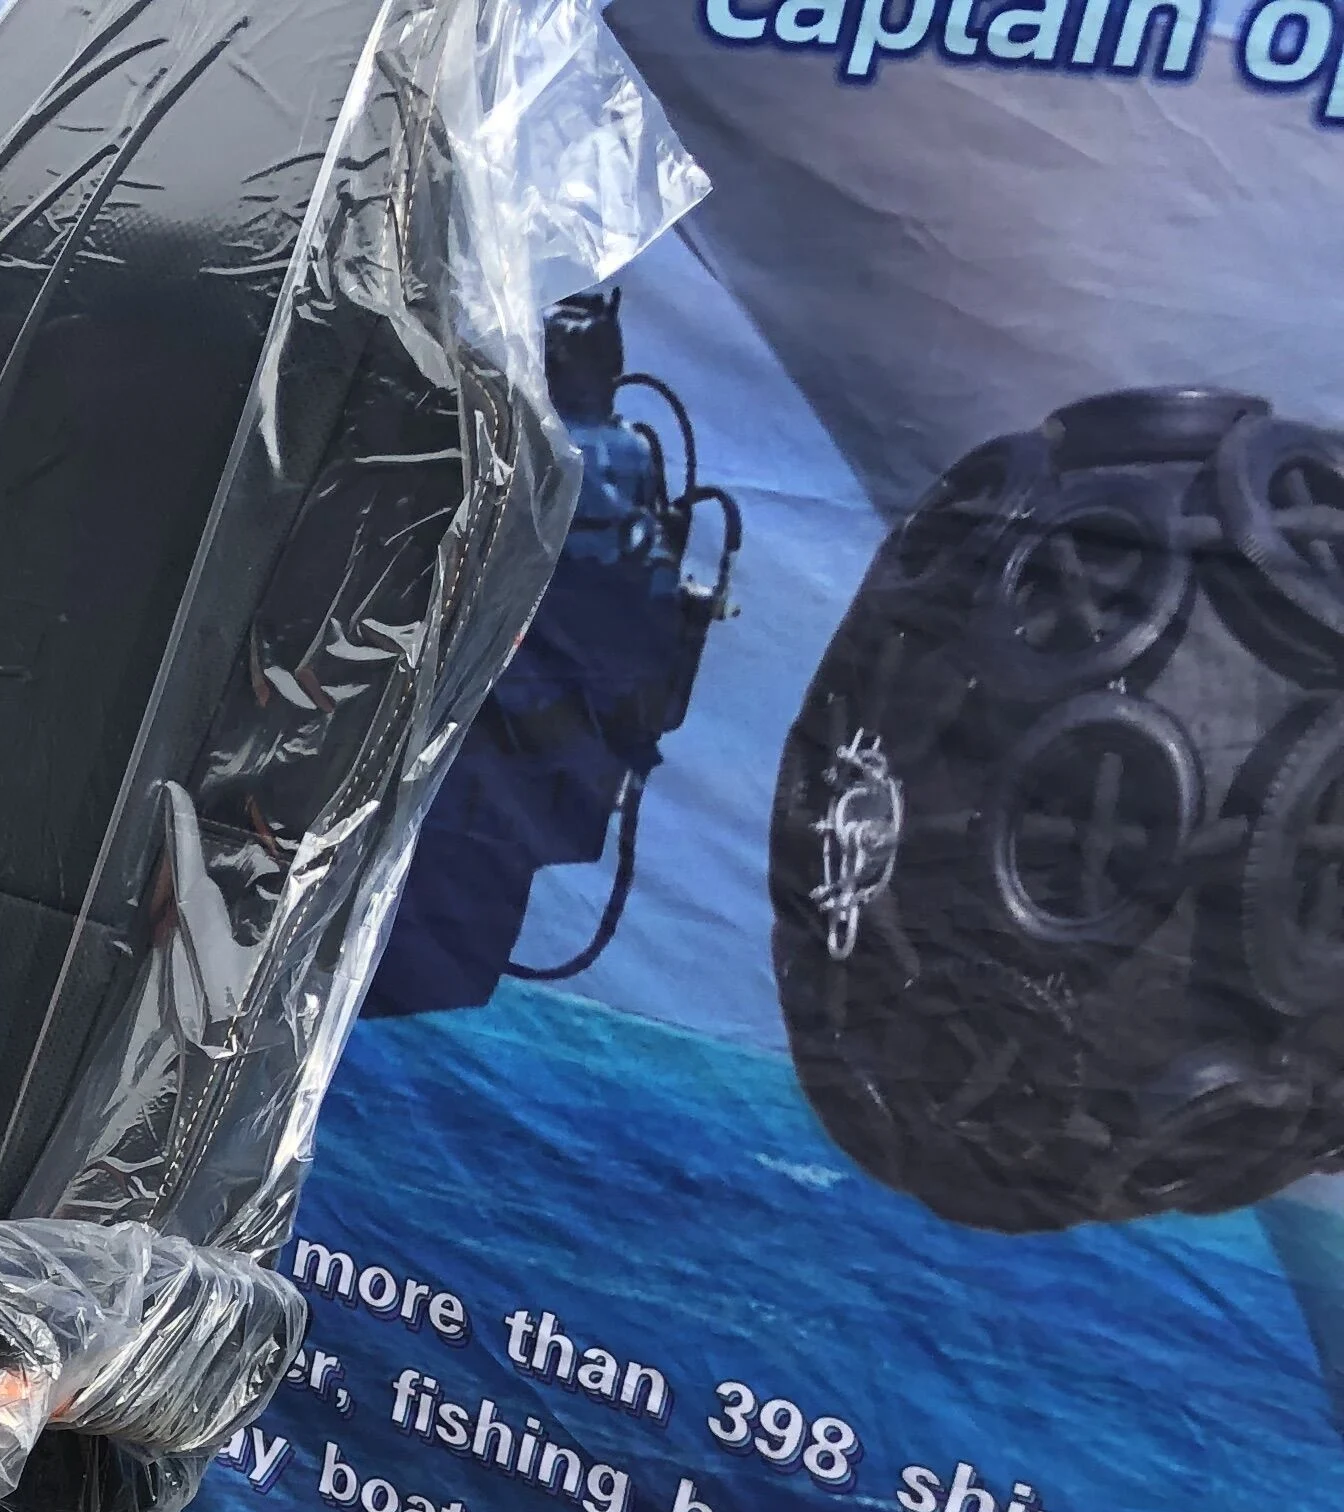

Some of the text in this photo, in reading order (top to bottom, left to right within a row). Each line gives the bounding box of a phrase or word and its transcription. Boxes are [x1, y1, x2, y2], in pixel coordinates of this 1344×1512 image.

[293, 1239, 465, 1335] more
[505, 1311, 665, 1413] than
[708, 1382, 855, 1479] 398
